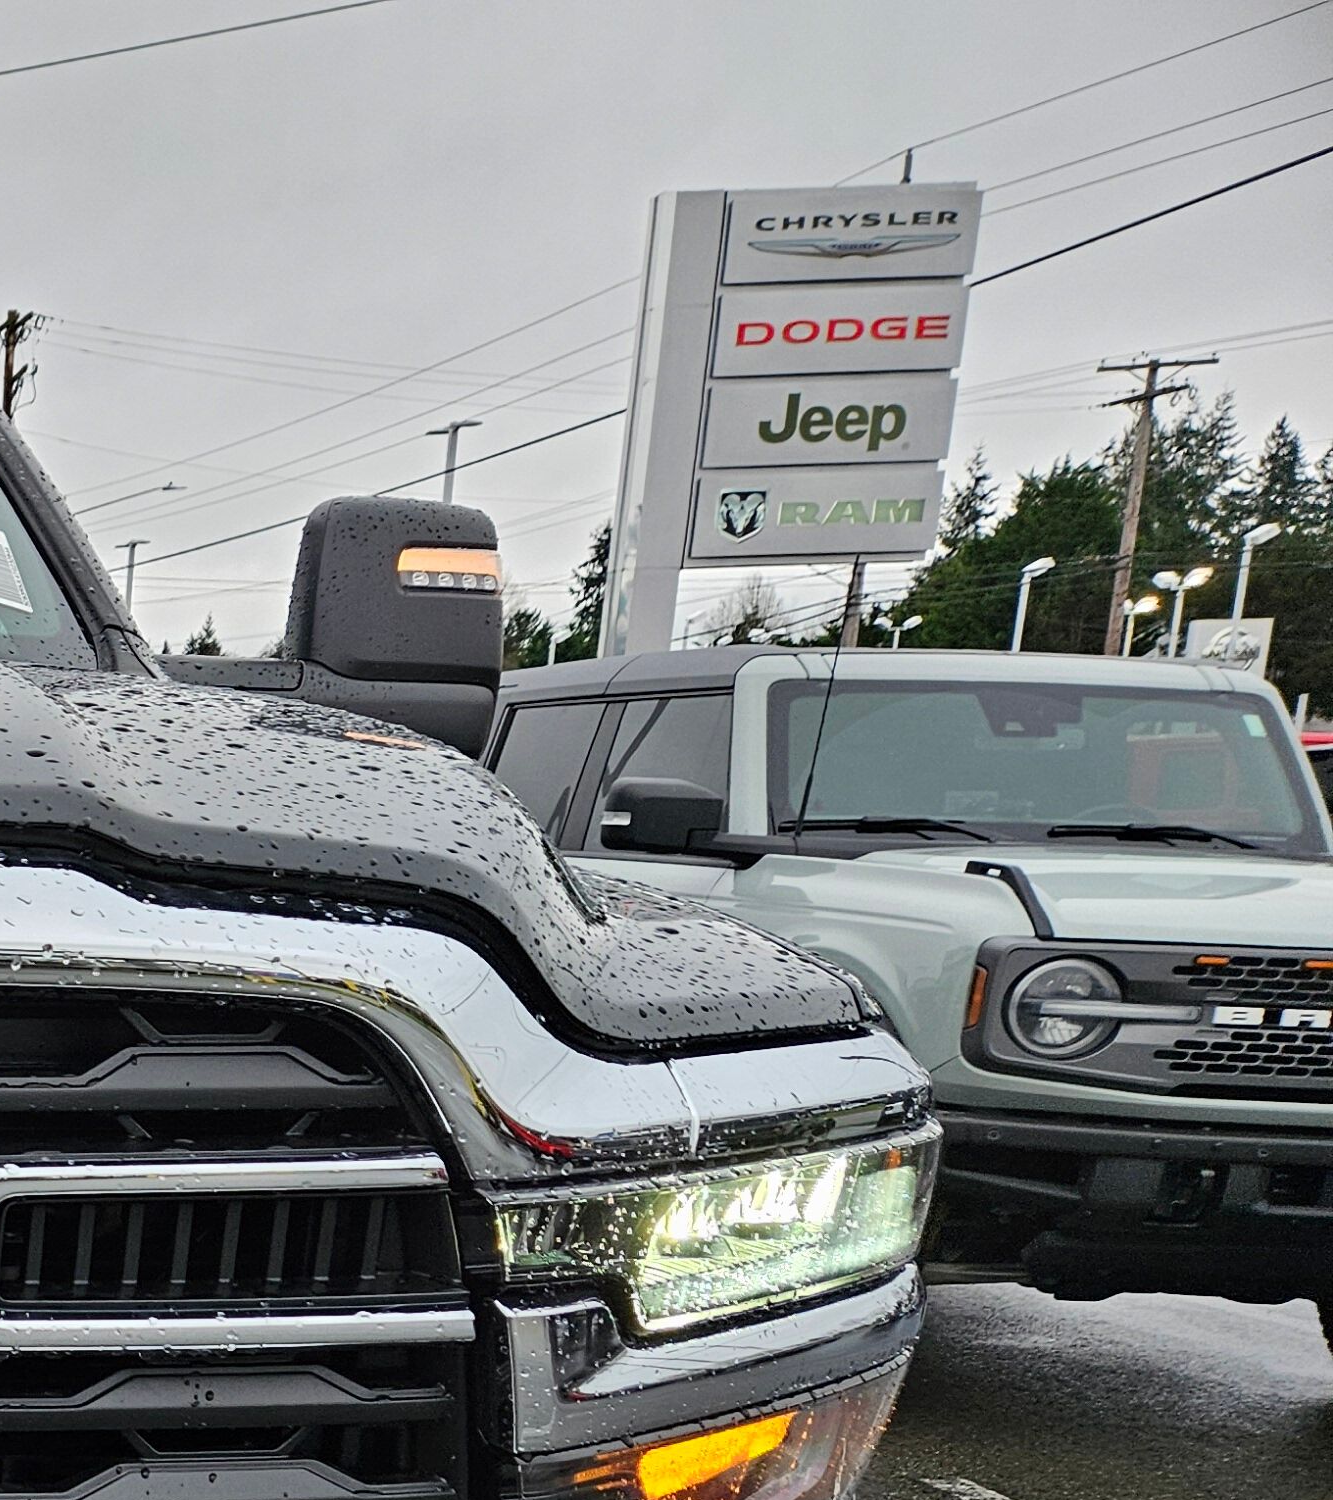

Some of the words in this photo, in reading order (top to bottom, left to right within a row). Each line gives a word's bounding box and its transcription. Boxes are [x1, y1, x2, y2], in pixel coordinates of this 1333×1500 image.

[754, 210, 960, 232] CHRYSLER
[735, 314, 952, 347] DODGE
[758, 391, 908, 452] Jeep
[776, 498, 927, 527] RAM
